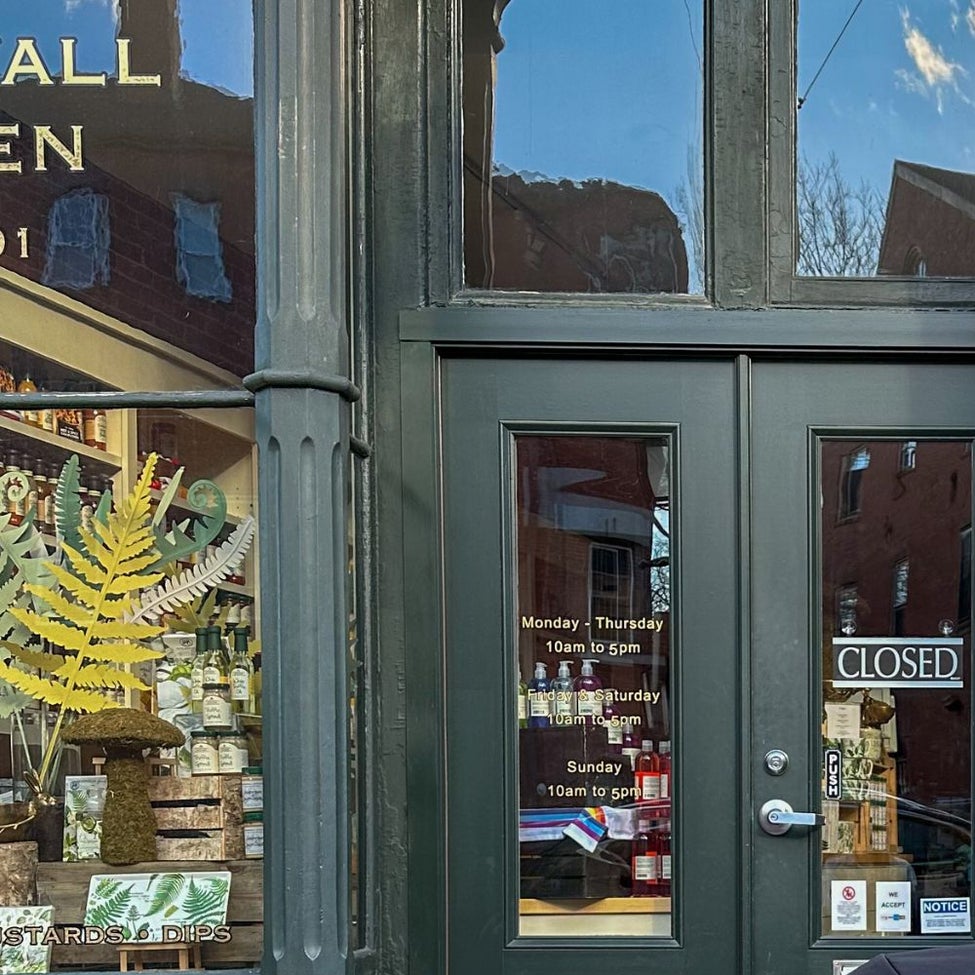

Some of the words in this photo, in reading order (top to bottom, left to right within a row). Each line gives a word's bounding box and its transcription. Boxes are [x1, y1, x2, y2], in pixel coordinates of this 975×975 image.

[0, 38, 161, 87] ALL
[0, 227, 29, 257] 1
[522, 617, 579, 631] Monday
[595, 617, 664, 632] Thursday
[546, 641, 585, 654] 10am
[591, 642, 604, 654] to
[609, 643, 641, 656] 5pm
[838, 647, 959, 679] CLOSED
[528, 689, 573, 704] Friday
[595, 689, 660, 704] Saturday
[548, 713, 586, 725] 10am
[592, 714, 605, 725] to
[611, 716, 642, 728] 5pm
[567, 761, 622, 776] Sunday
[829, 754, 838, 796] PUSH
[548, 785, 587, 797] 10am
[592, 785, 606, 797] to
[611, 787, 642, 800] 5pm
[923, 901, 967, 912] NOTICE
[0, 925, 125, 946] STARDS
[162, 925, 232, 943] DIPS
